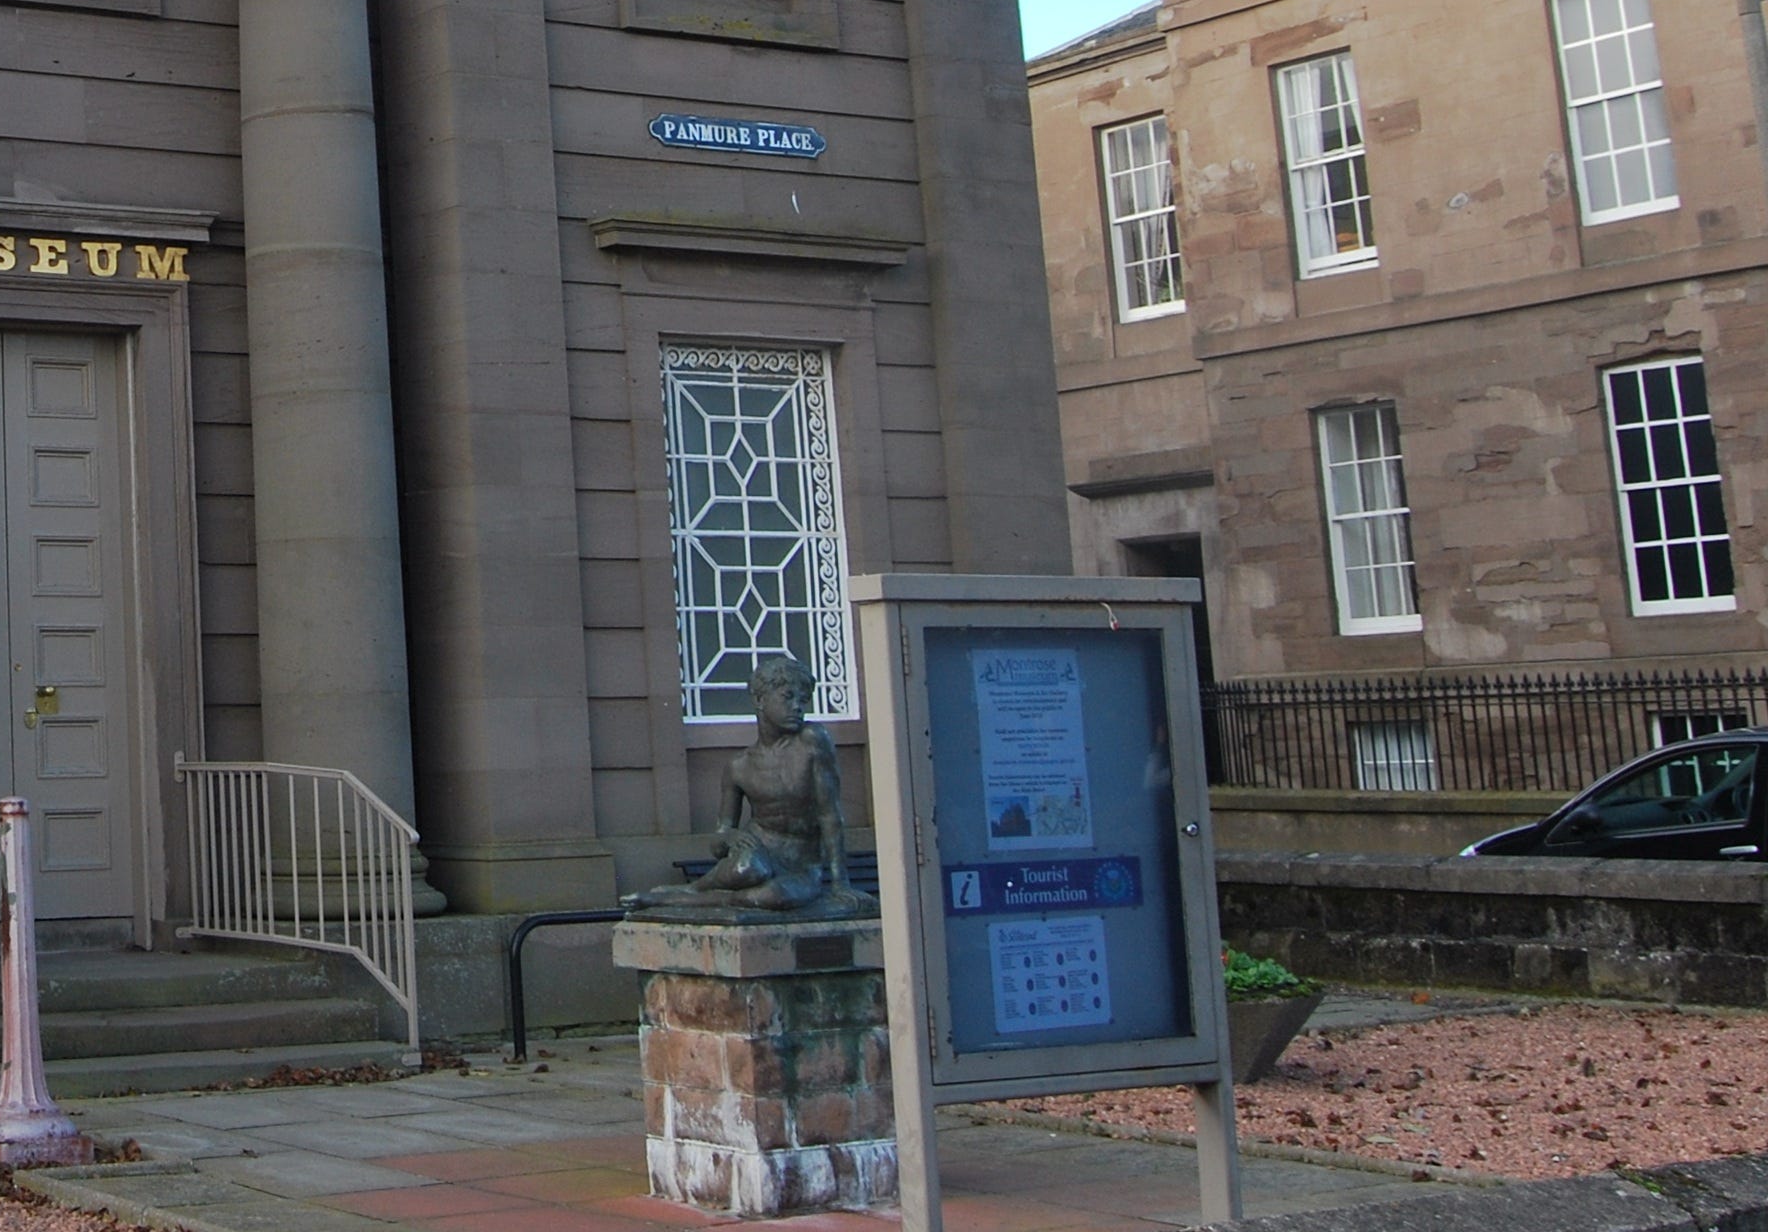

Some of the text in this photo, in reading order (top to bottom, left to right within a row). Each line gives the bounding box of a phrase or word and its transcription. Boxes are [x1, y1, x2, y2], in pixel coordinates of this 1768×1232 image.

[663, 121, 751, 145] PANMURE
[1020, 867, 1069, 884] Tourist
[1005, 885, 1087, 905] Information
